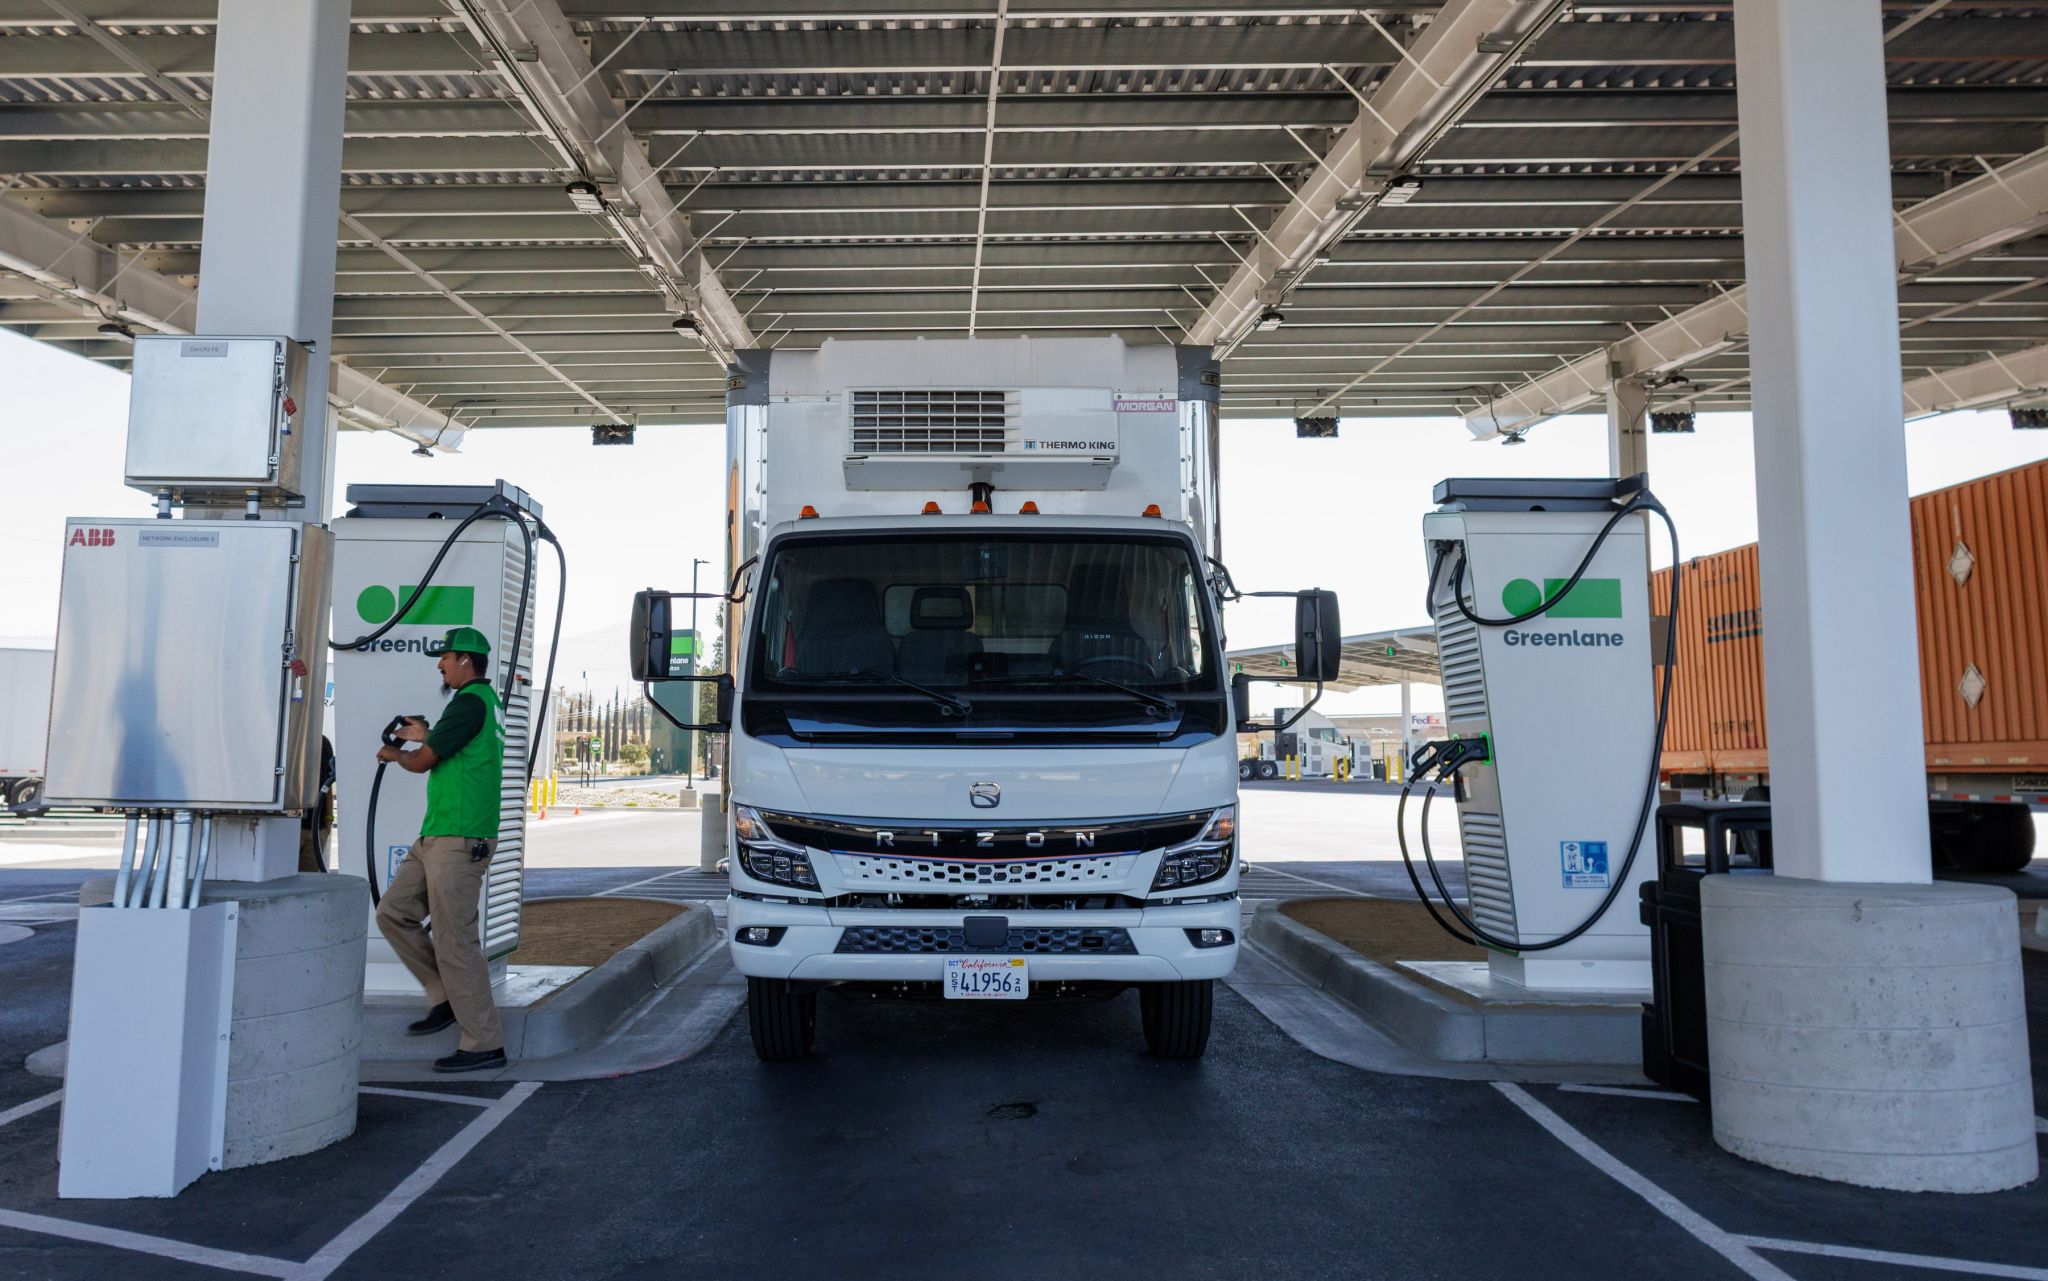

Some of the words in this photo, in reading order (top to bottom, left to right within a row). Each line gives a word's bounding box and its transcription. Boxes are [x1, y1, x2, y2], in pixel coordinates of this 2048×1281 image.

[1116, 402, 1173, 411] MORGAN
[1039, 441, 1087, 450] THERMO
[1089, 441, 1115, 450] KING
[69, 528, 115, 547] ABB
[355, 636, 446, 653] Greenla
[1503, 629, 1624, 647] Greenlane
[1411, 715, 1440, 724] FedEx
[876, 831, 1095, 847] RIZON
[961, 959, 1010, 971] California
[961, 972, 1012, 992] 41956
